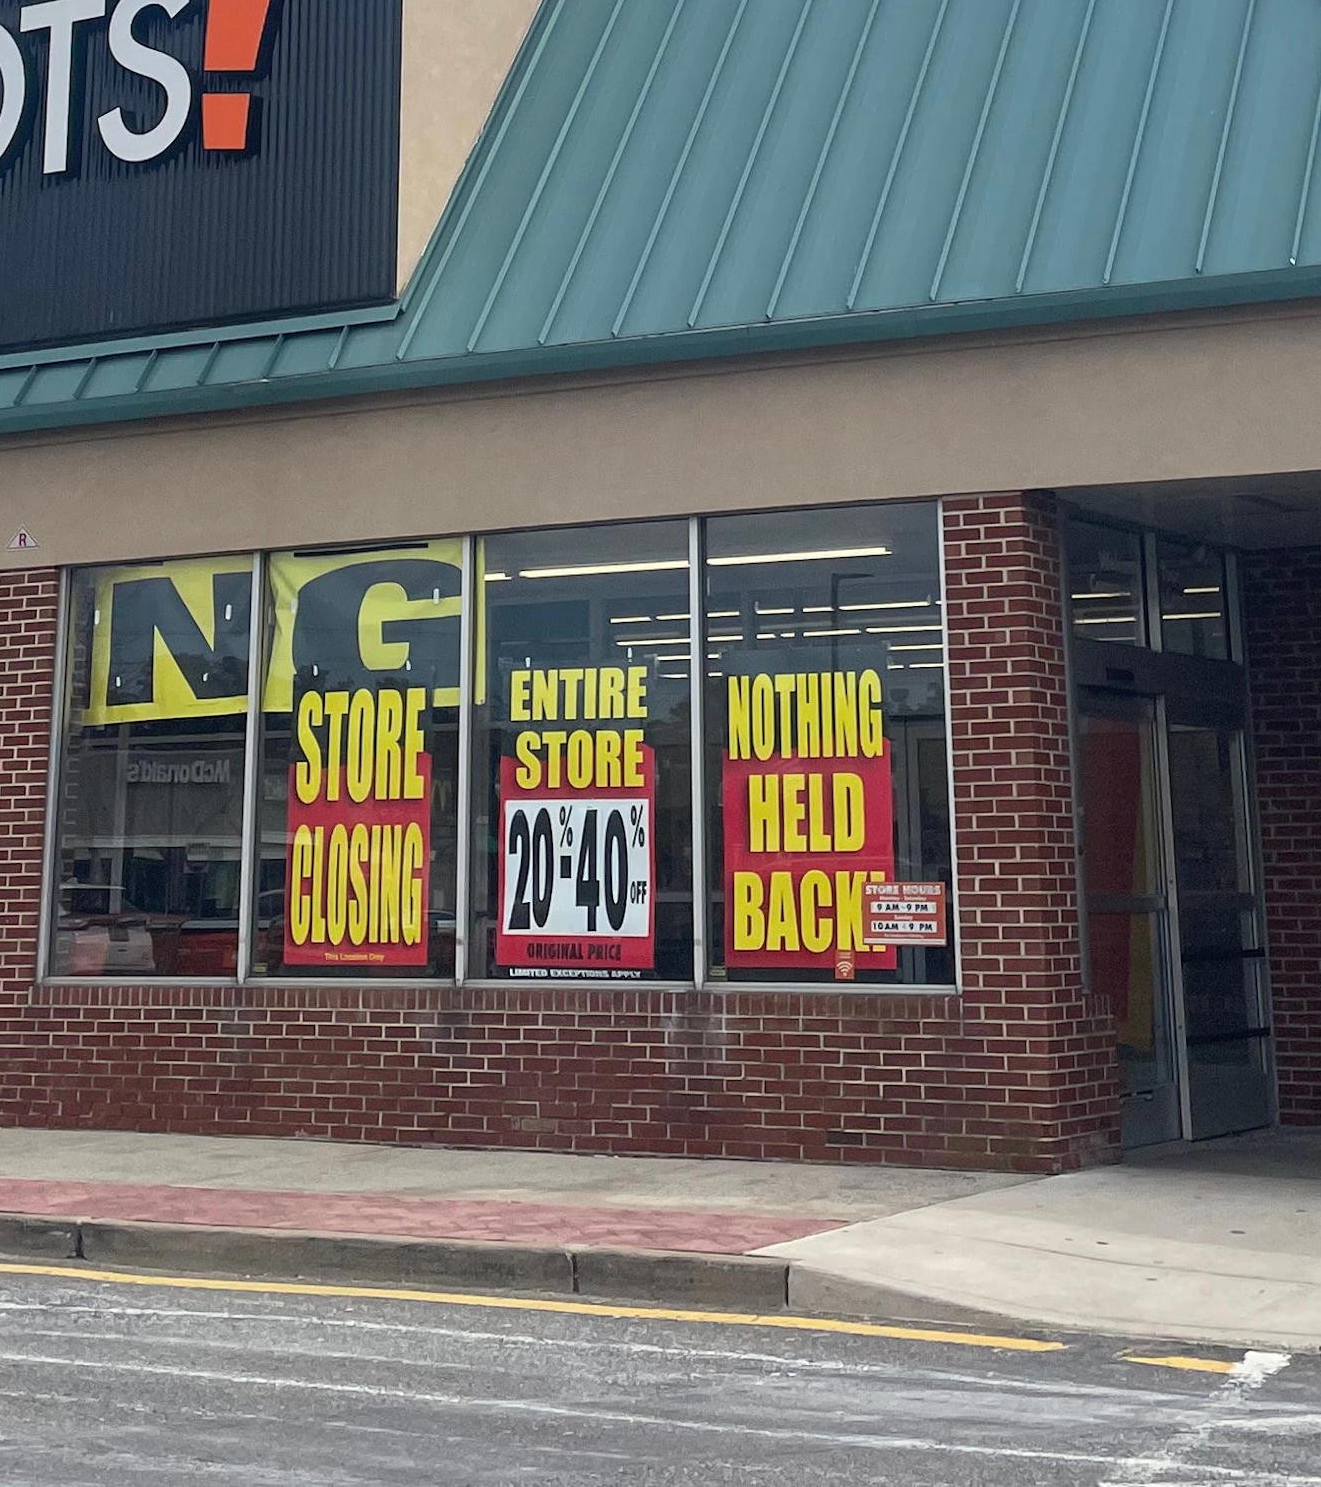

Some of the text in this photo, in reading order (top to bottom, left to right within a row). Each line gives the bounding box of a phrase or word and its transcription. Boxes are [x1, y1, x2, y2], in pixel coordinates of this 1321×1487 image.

[19, 533, 27, 547] R
[510, 666, 648, 721] ENTIRE
[728, 669, 883, 761] NOTHING
[295, 689, 426, 804] STORE
[516, 729, 645, 789] STORE
[748, 772, 865, 852] HELD
[290, 822, 424, 946] CLOSING
[630, 880, 647, 905] OFF
[734, 869, 886, 953] BACK
[865, 884, 941, 895] STORE HOURS
[527, 942, 621, 961] ORIGINAL PRICE
[919, 923, 933, 931] PM
[509, 968, 642, 979] LIMITED EXCEPTIONS APPLY
